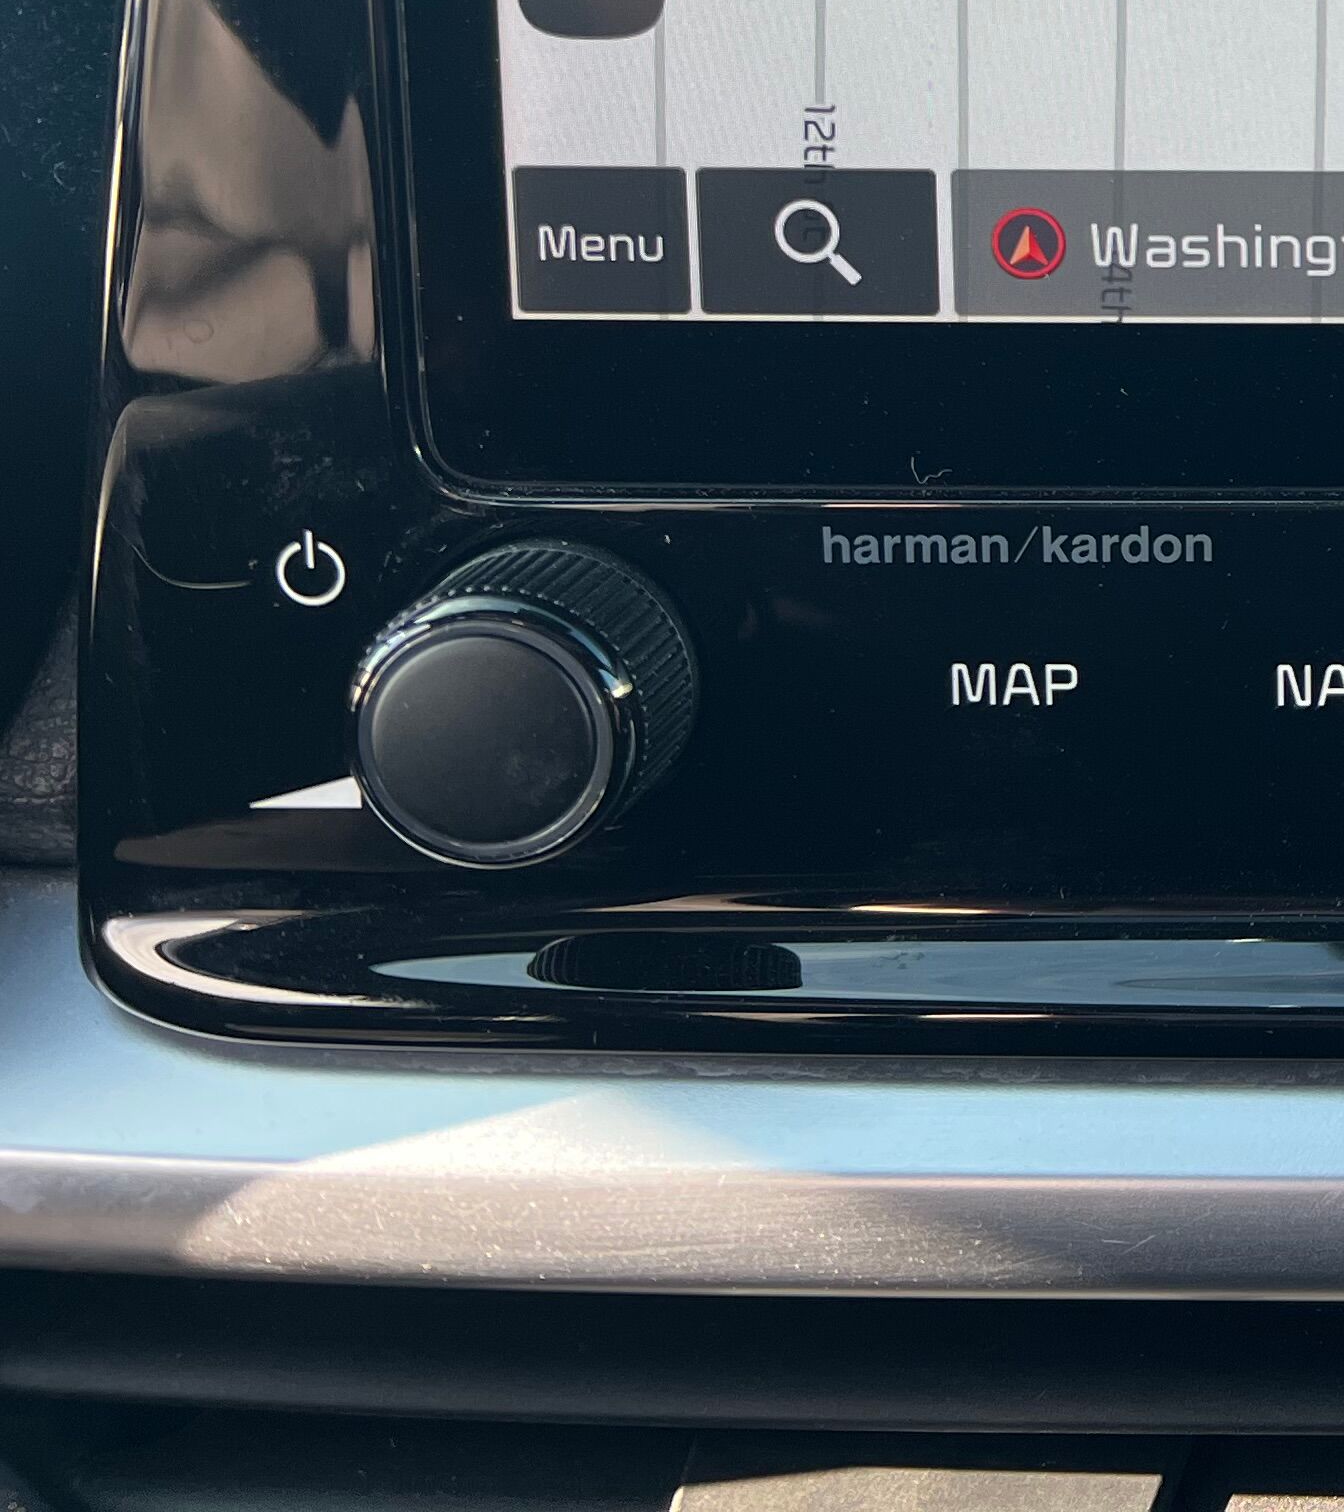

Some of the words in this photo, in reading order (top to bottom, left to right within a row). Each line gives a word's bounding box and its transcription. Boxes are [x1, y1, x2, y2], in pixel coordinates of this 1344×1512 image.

[537, 224, 665, 263] Menu
[822, 523, 1213, 566] harman/kardon
[950, 663, 1079, 707] MAP
